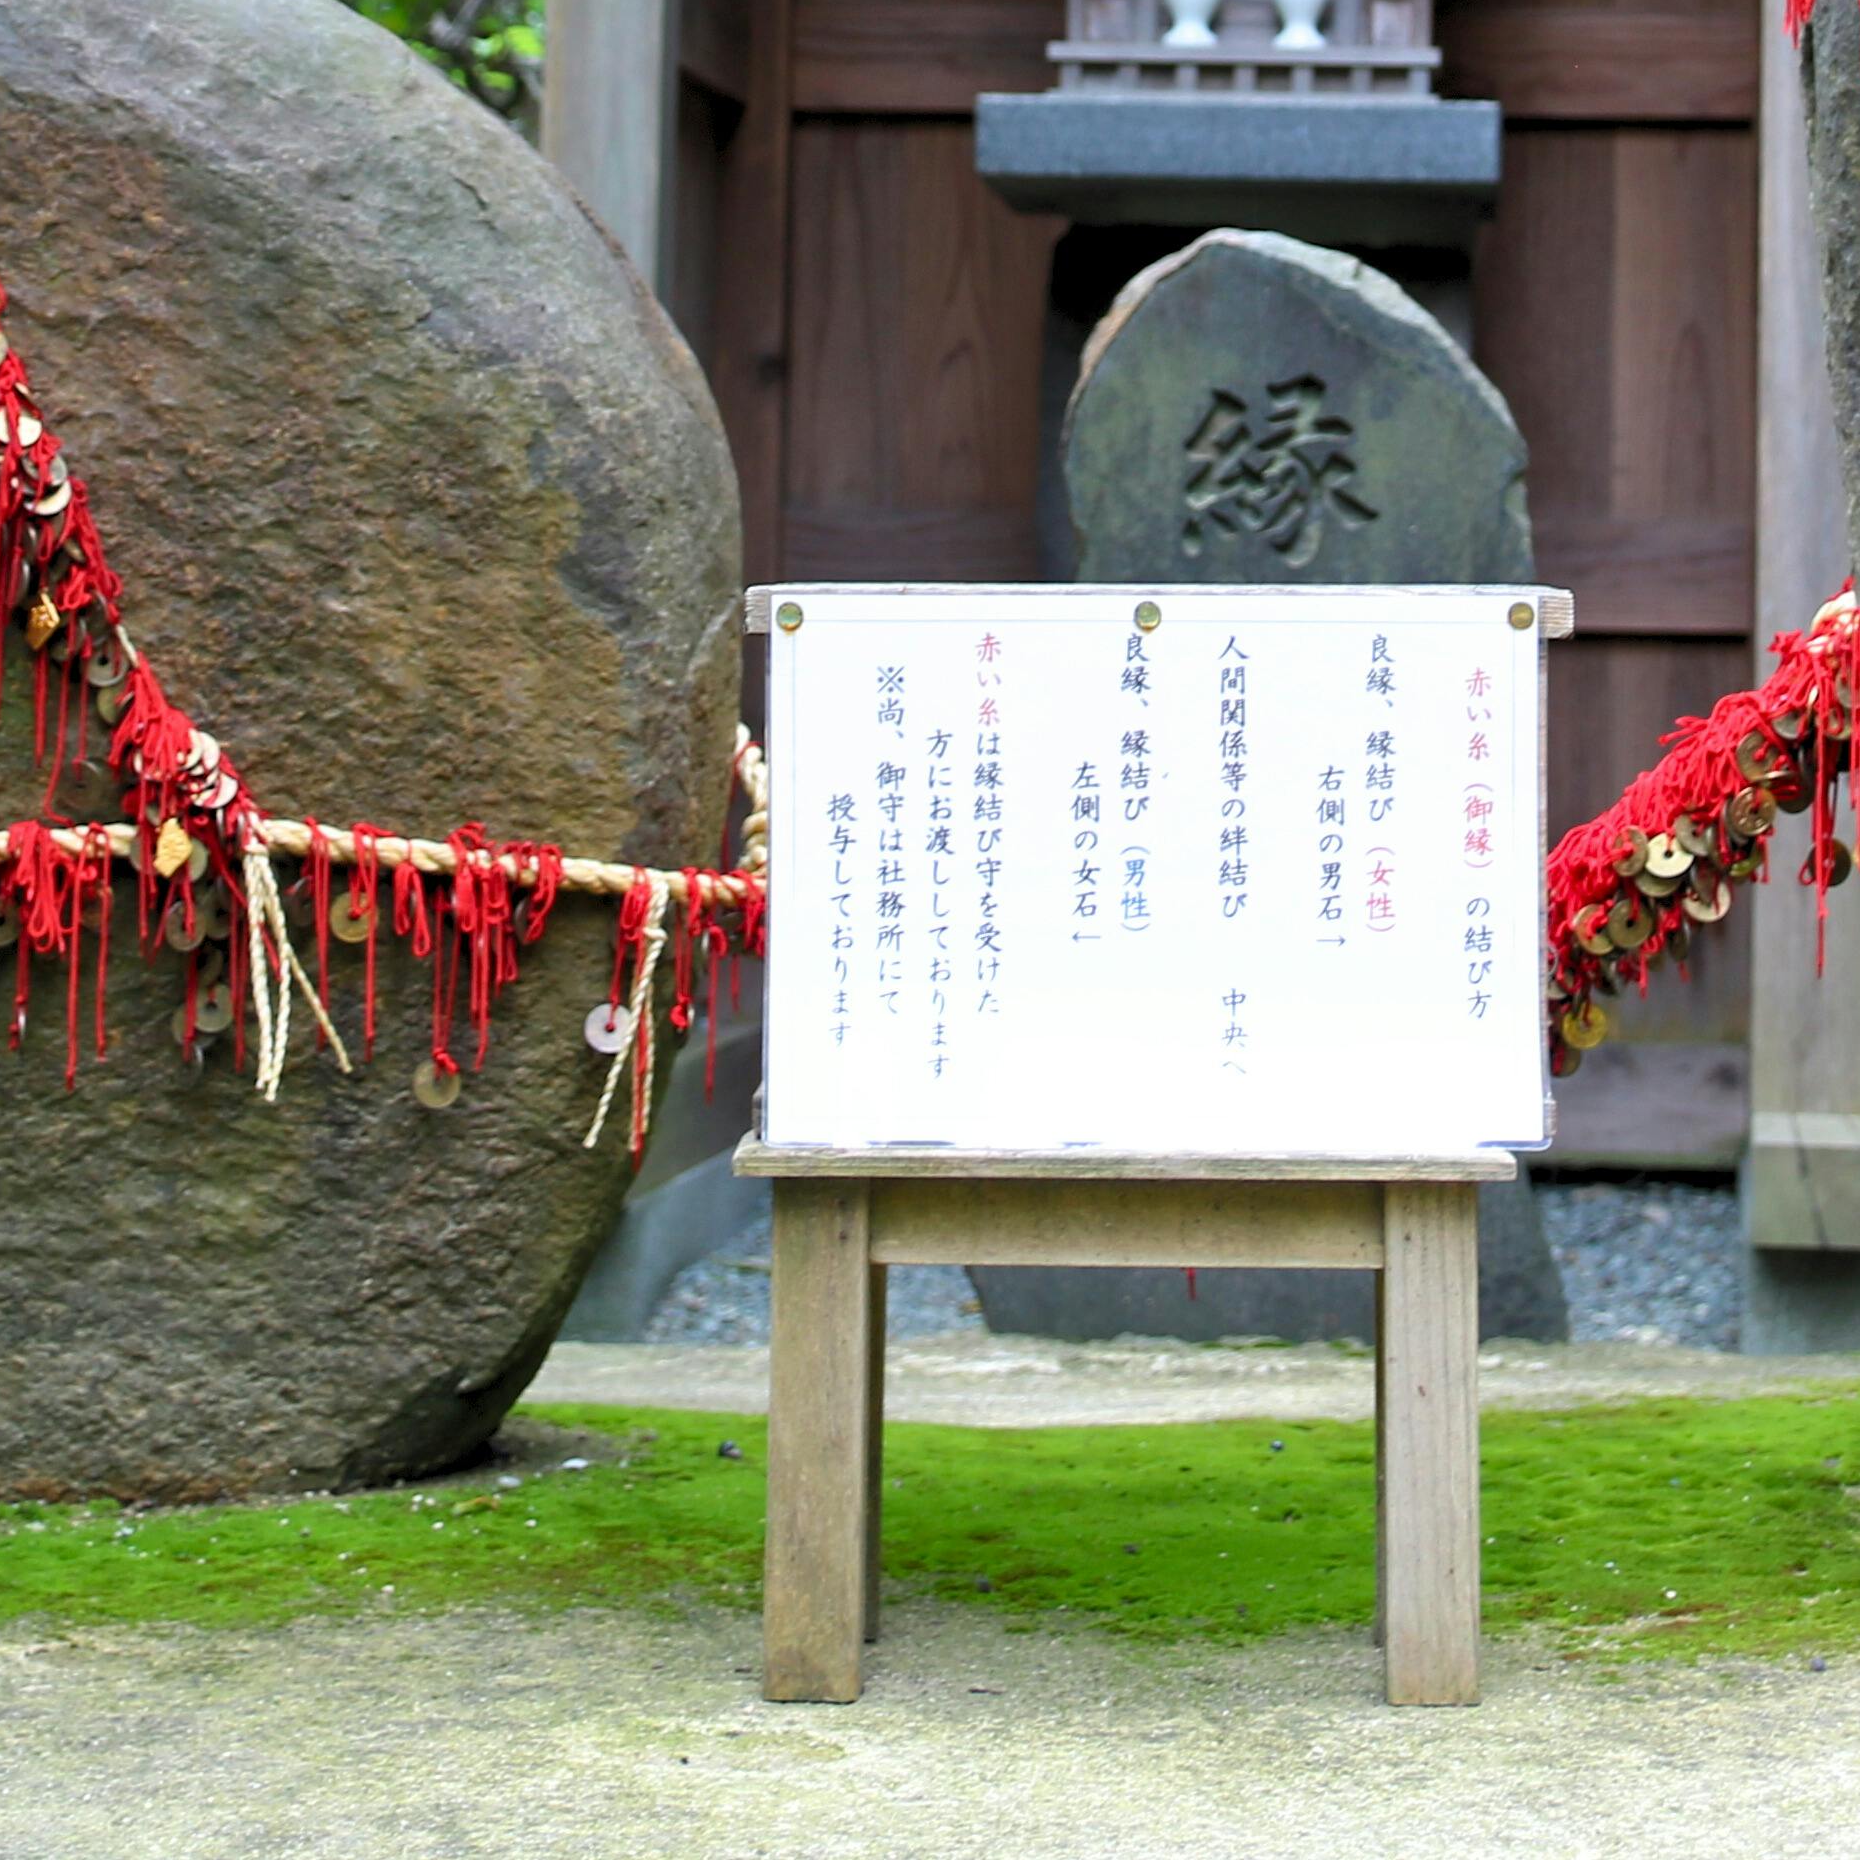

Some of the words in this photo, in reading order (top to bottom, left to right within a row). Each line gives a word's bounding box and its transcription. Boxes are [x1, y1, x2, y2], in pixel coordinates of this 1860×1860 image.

[1182, 373, 1380, 568] 縁
[973, 632, 1004, 1013] 赤い糸は縁結び守を受けた
[1069, 761, 1101, 918] 左側の女石
[1218, 635, 1250, 918] 人間関係等の絆結び
[1316, 764, 1345, 921] 右側の男石
[826, 793, 858, 1046] 授与しております
[925, 729, 956, 1078] 方にお渡ししております
[1222, 988, 1247, 1073] 中央へ
